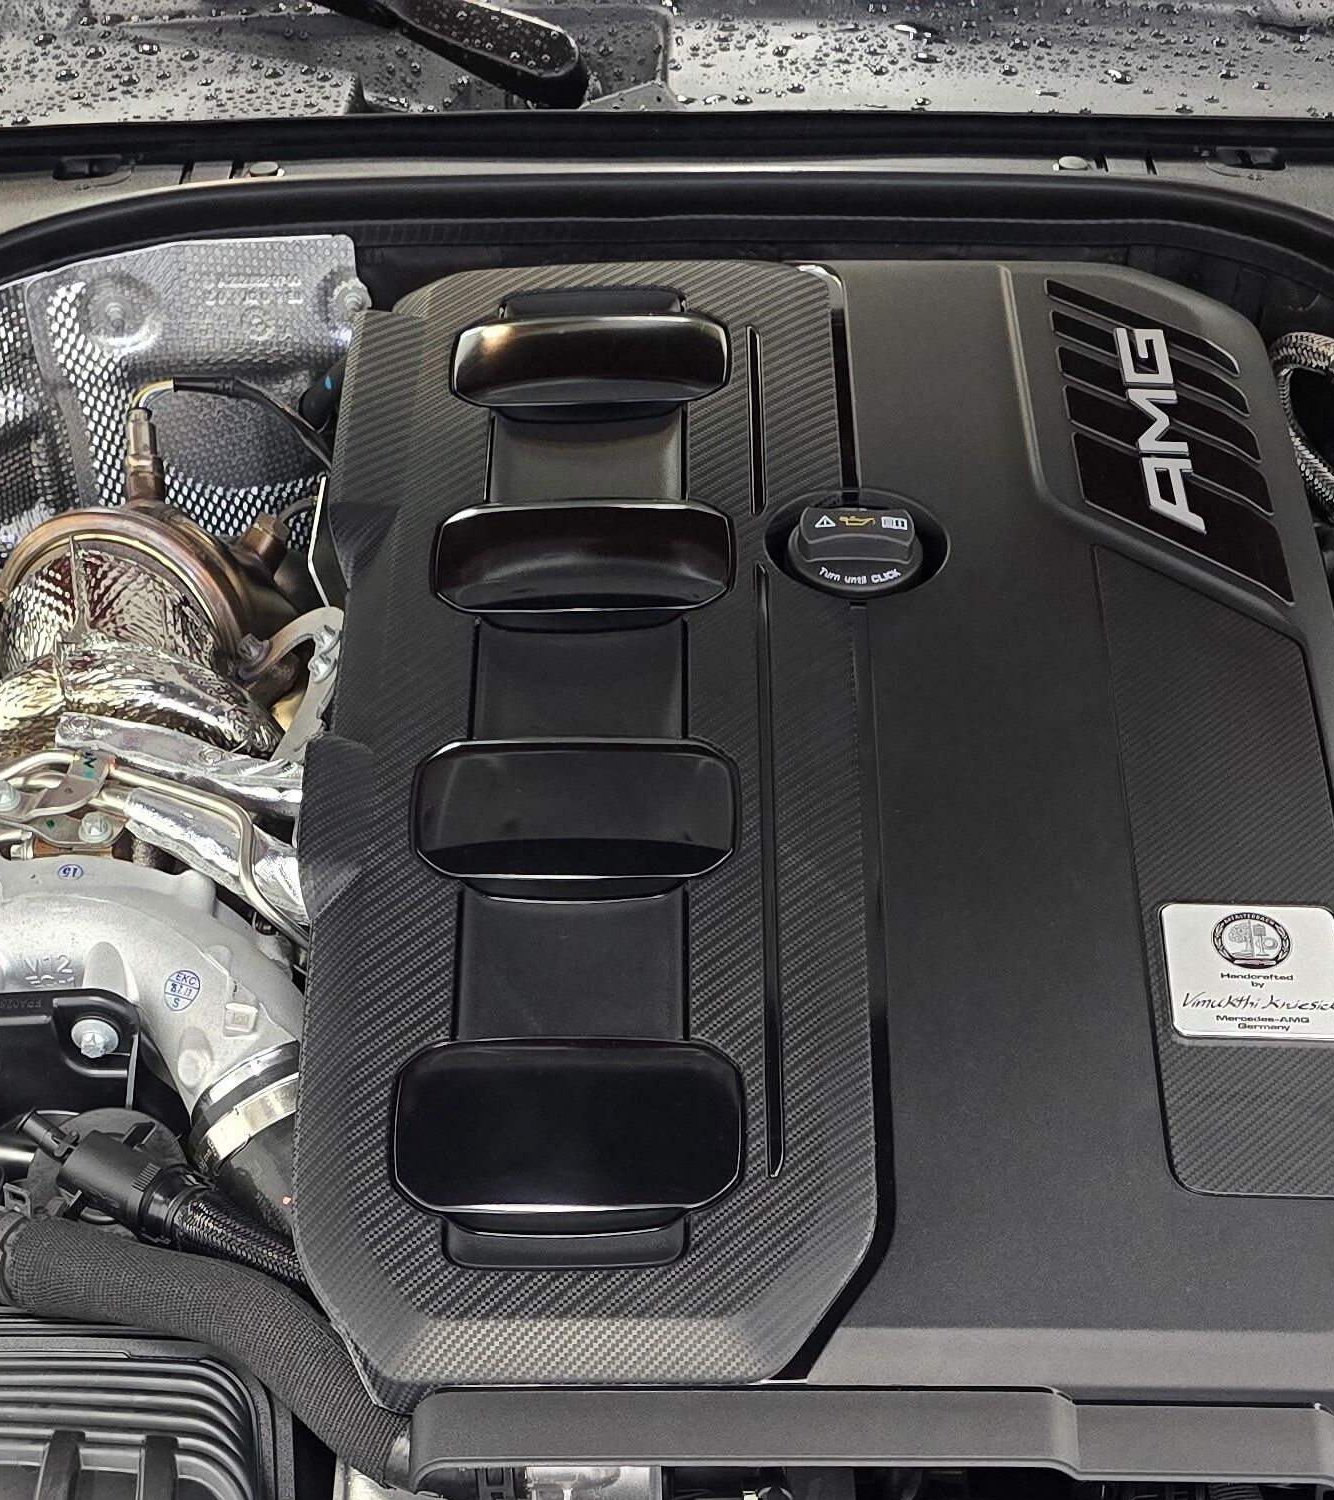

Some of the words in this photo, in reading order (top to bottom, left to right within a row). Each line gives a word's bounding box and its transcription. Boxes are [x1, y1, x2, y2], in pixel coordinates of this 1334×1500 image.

[1113, 327, 1208, 535] AMG
[818, 566, 841, 581] Turn
[844, 575, 867, 584] until
[870, 568, 902, 583] CLICK
[175, 973, 197, 986] EKC
[1220, 972, 1294, 981] Handcrafted
[1250, 981, 1265, 989] by
[1216, 1014, 1310, 1024] Mercedes-AMG
[1237, 1023, 1290, 1032] Germany
